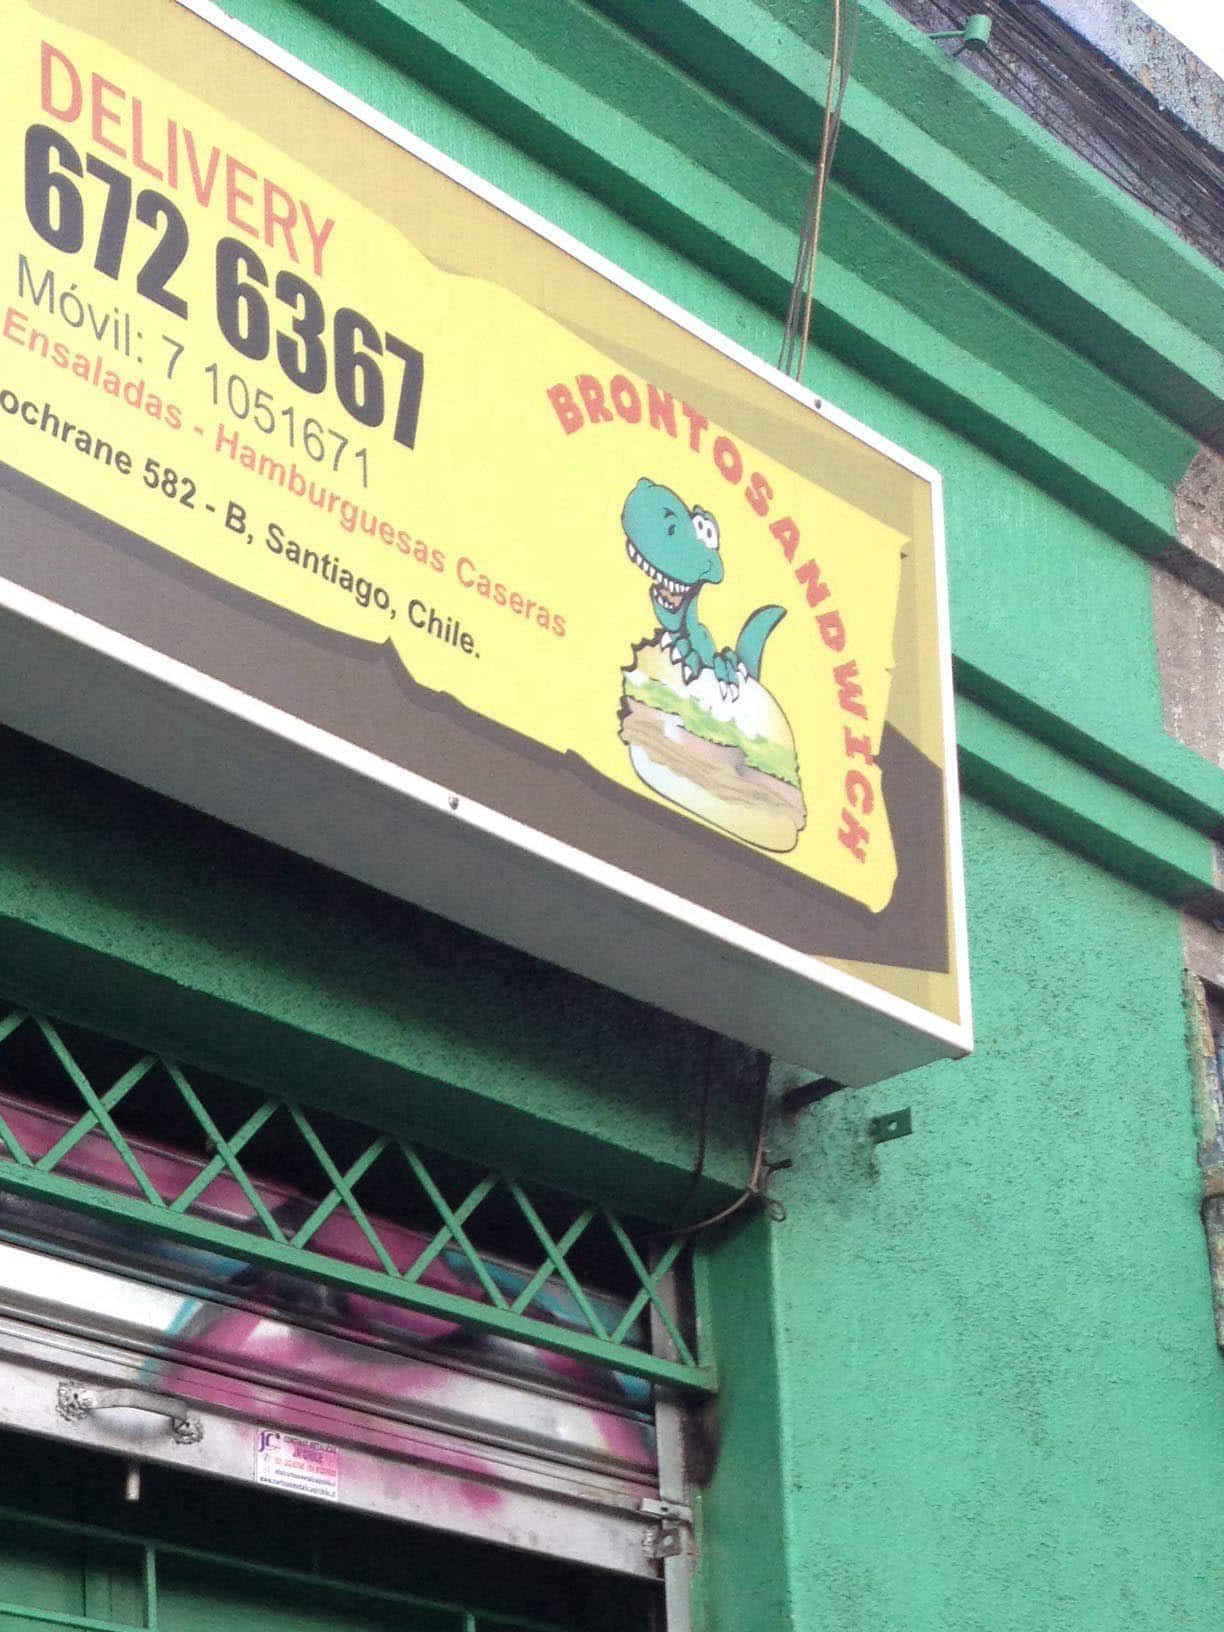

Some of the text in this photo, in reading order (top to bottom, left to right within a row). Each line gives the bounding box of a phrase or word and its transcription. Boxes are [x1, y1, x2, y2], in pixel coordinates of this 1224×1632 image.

[24, 124, 189, 319] 672
[215, 237, 424, 450] 6367
[40, 40, 336, 276] DELIVERY
[3, 312, 183, 430] Ensaladas
[215, 426, 446, 573] Hamburguesas
[456, 556, 567, 638] Caseras
[17, 255, 372, 488] Móvil: 7 1051671
[143, 459, 197, 511] 582
[225, 502, 255, 545] B,
[265, 524, 398, 620] Santiago,
[408, 599, 482, 659] Chile.
[545, 374, 882, 864] BRONTOSANDWICH
